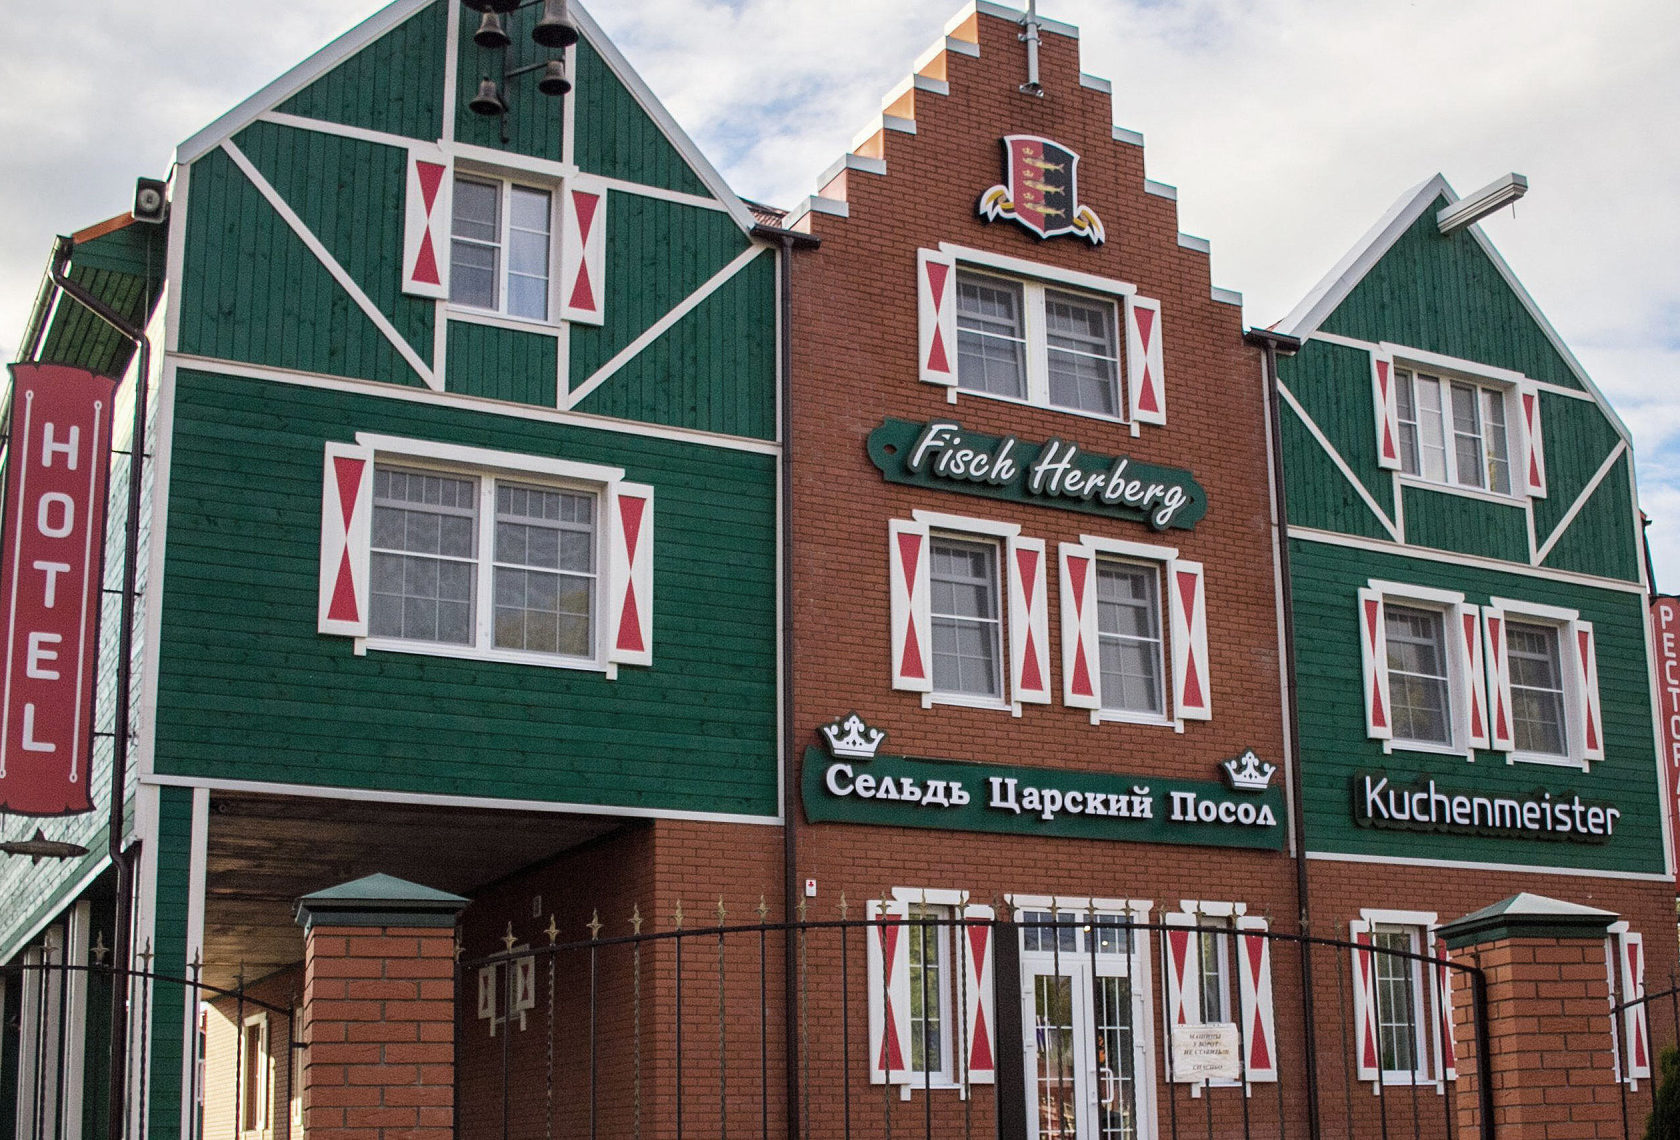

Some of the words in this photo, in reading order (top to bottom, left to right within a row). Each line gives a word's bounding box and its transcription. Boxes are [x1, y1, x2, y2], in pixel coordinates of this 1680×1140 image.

[911, 423, 1016, 480] Fisch
[1032, 440, 1186, 526] Herberg
[22, 422, 79, 753] HOTEL
[1659, 605, 1680, 815] РЕСТОР
[825, 763, 971, 808] Сельдь
[988, 775, 1153, 820] Царский
[1170, 790, 1277, 826] Посол
[1365, 775, 1621, 836] Kuchenmeister
